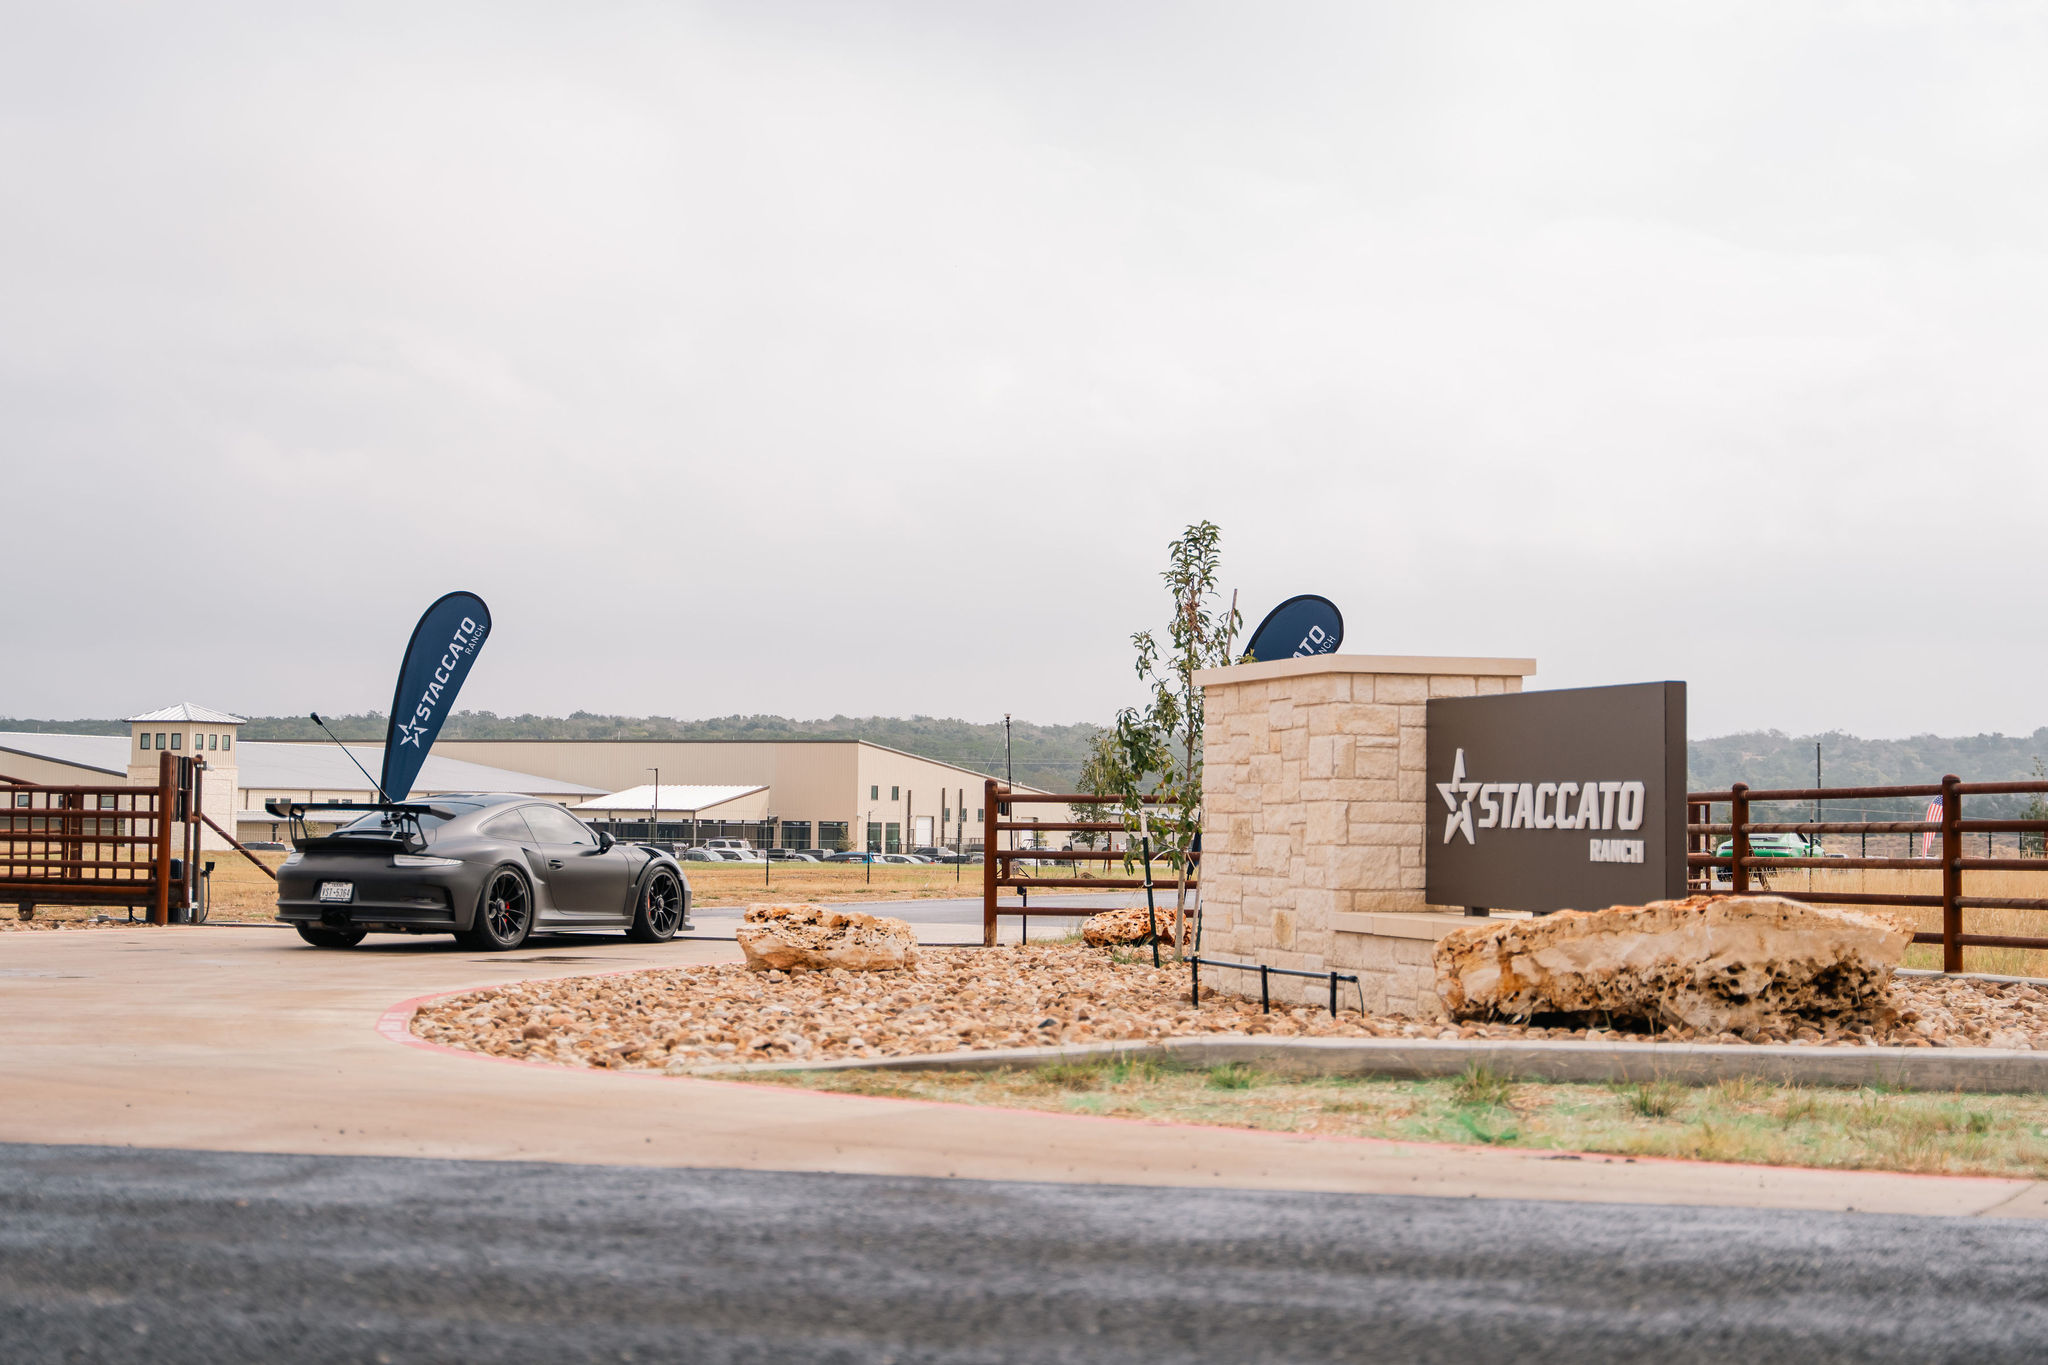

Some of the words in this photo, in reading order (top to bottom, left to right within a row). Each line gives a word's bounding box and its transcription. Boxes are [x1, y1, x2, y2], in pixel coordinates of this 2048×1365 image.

[464, 624, 486, 655] RANCH
[416, 616, 476, 722] STACCATO
[1478, 781, 1646, 831] STACCATO
[1589, 838, 1645, 863] RANCH
